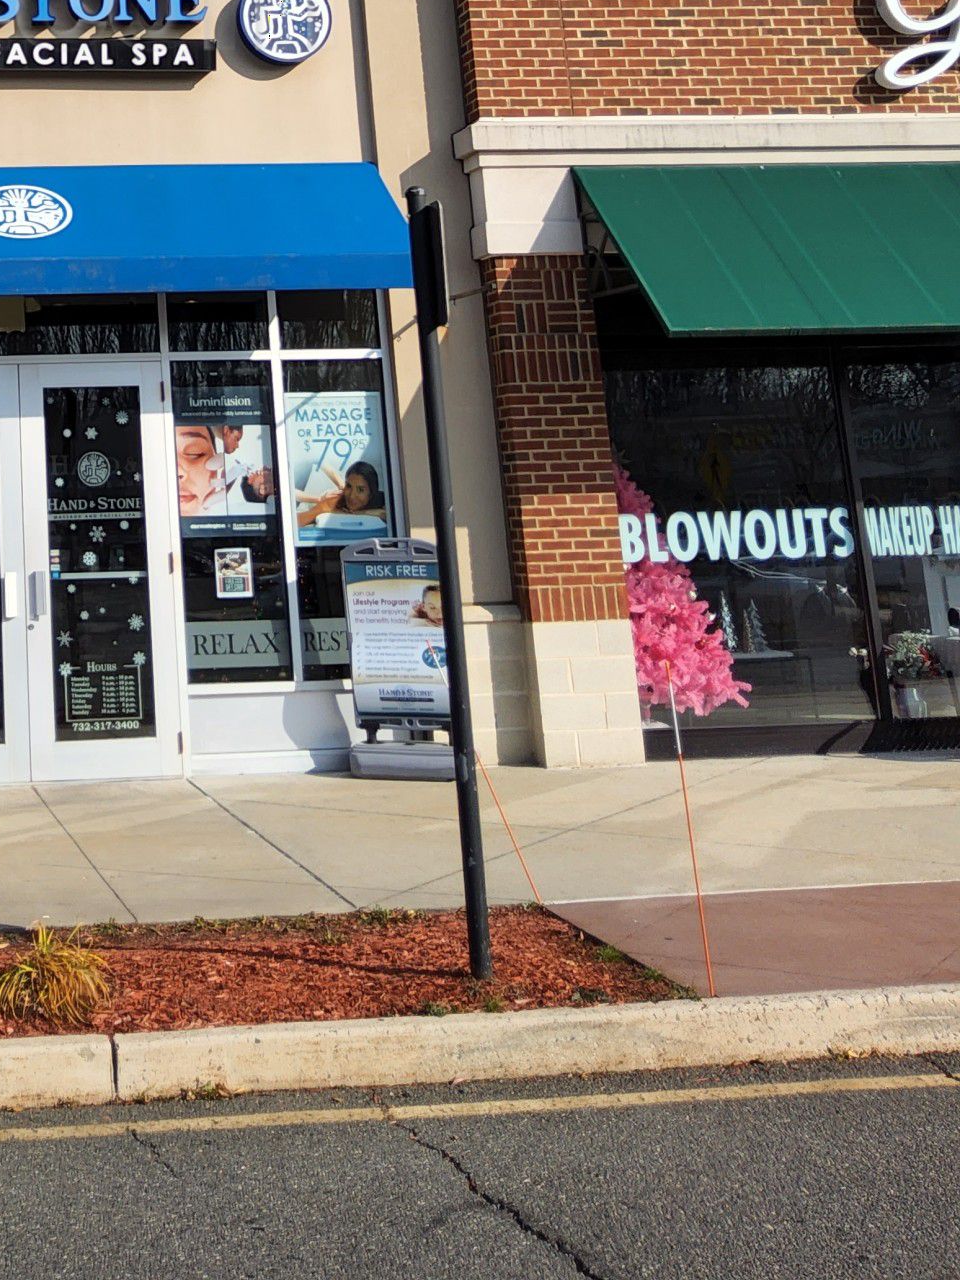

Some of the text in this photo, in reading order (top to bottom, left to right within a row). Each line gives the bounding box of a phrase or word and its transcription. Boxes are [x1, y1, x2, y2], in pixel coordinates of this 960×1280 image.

[131, 42, 195, 65] SPA
[189, 395, 251, 407] luminfusion
[295, 408, 372, 422] MASSAGE
[297, 423, 372, 438] OR FACIAL
[48, 498, 87, 512] HAND
[90, 500, 96, 509] &
[619, 506, 855, 564] BLOWOUTS
[864, 505, 935, 557] MAKEUP
[365, 564, 428, 577] RISK FREE
[353, 598, 410, 607] Lifestyle Program
[193, 632, 281, 655] RELAX
[87, 661, 117, 672] HOURS
[72, 720, 140, 732] 732-317-3400
